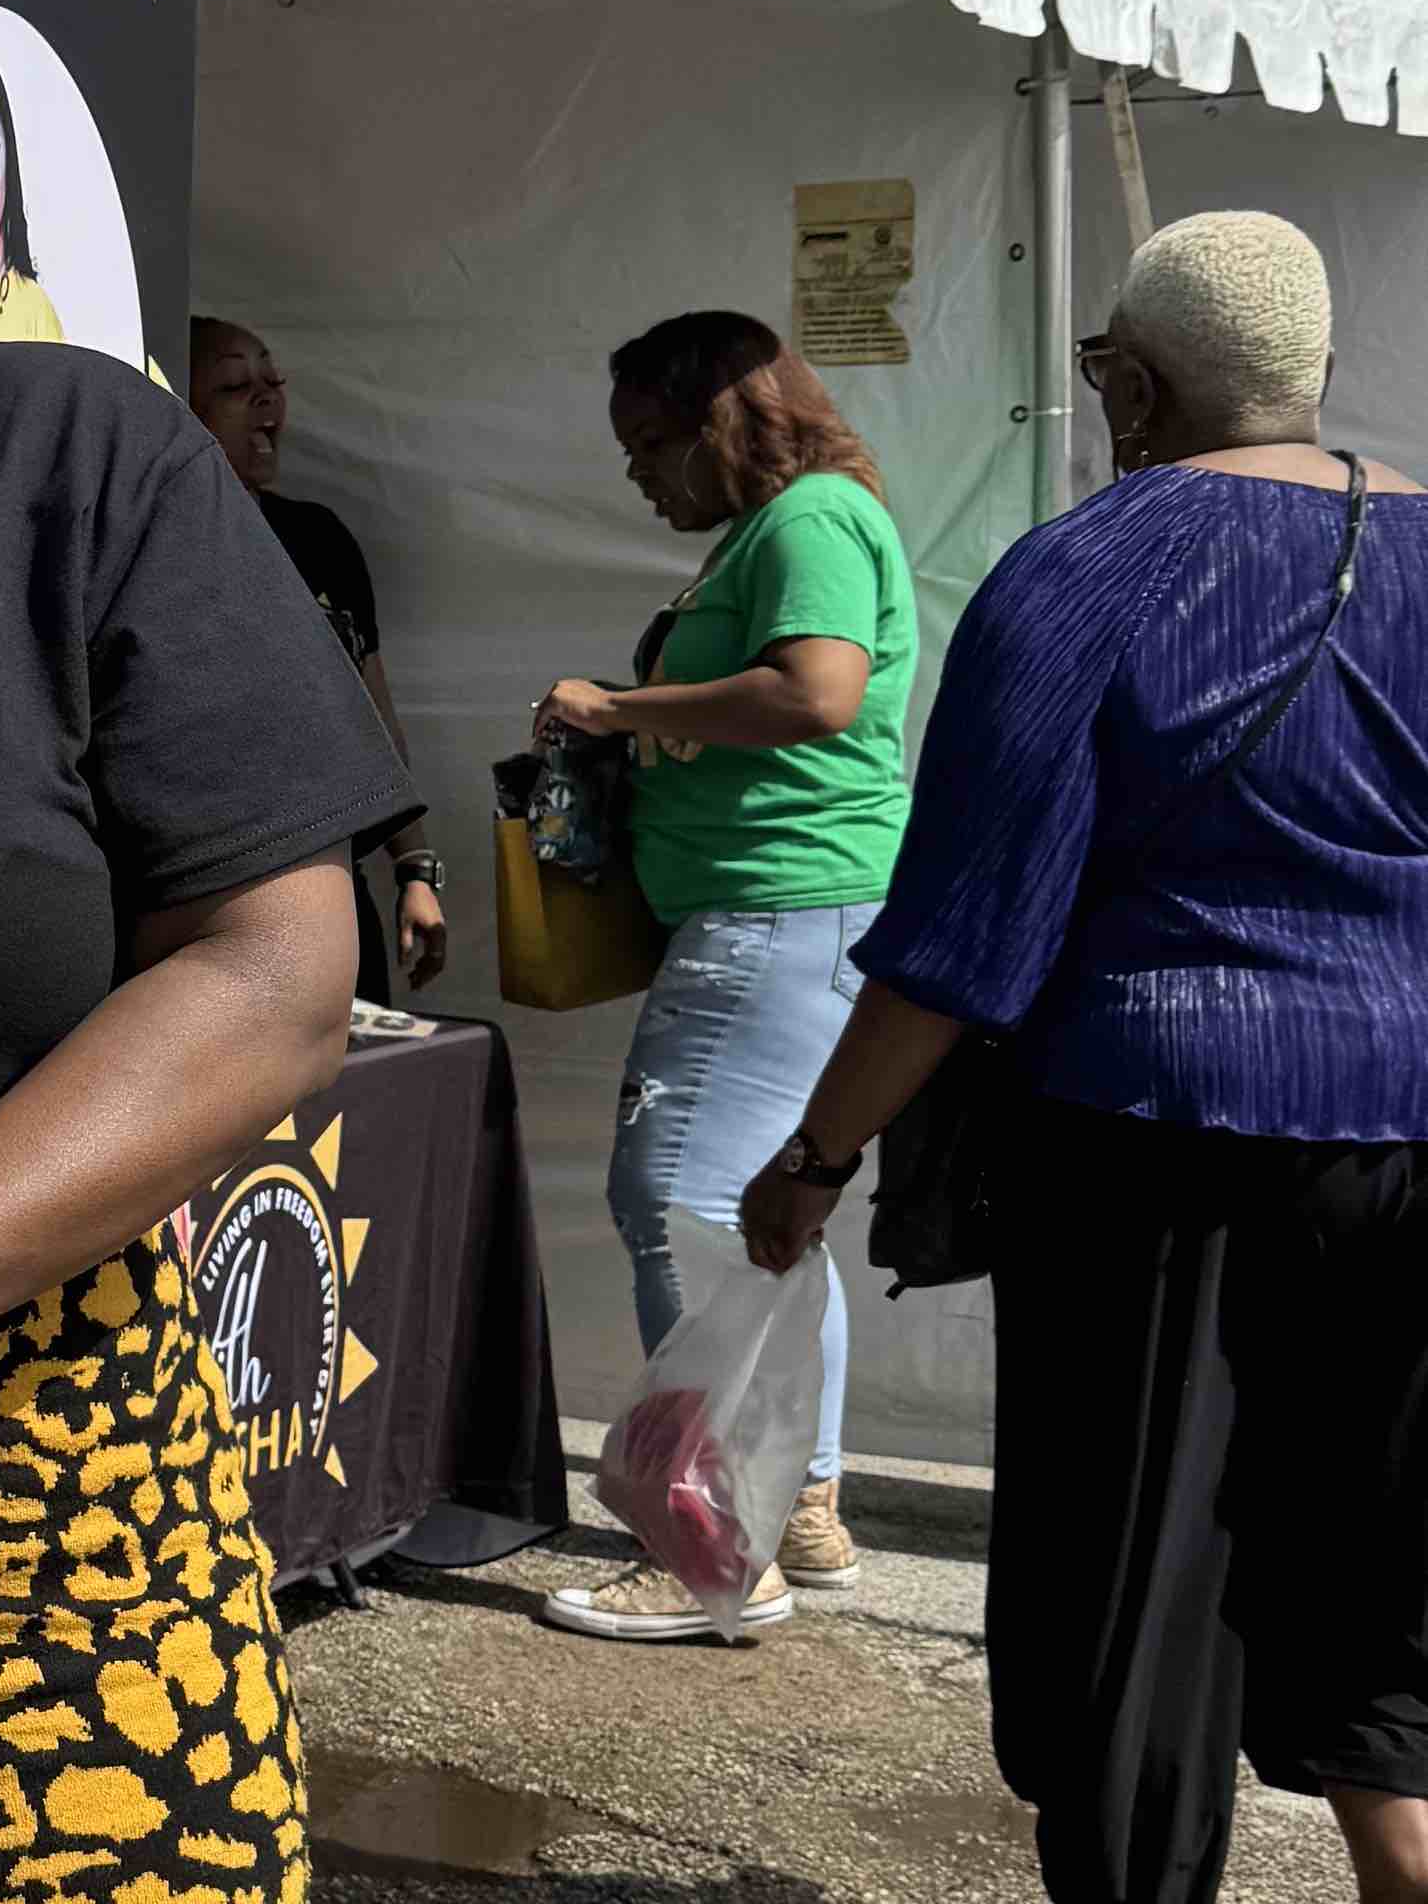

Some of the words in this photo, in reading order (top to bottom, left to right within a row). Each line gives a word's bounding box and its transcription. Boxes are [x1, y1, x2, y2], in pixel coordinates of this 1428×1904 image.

[201, 1205, 252, 1291] LIVING
[254, 1189, 273, 1216] IN
[275, 1187, 328, 1267] FREEDOM
